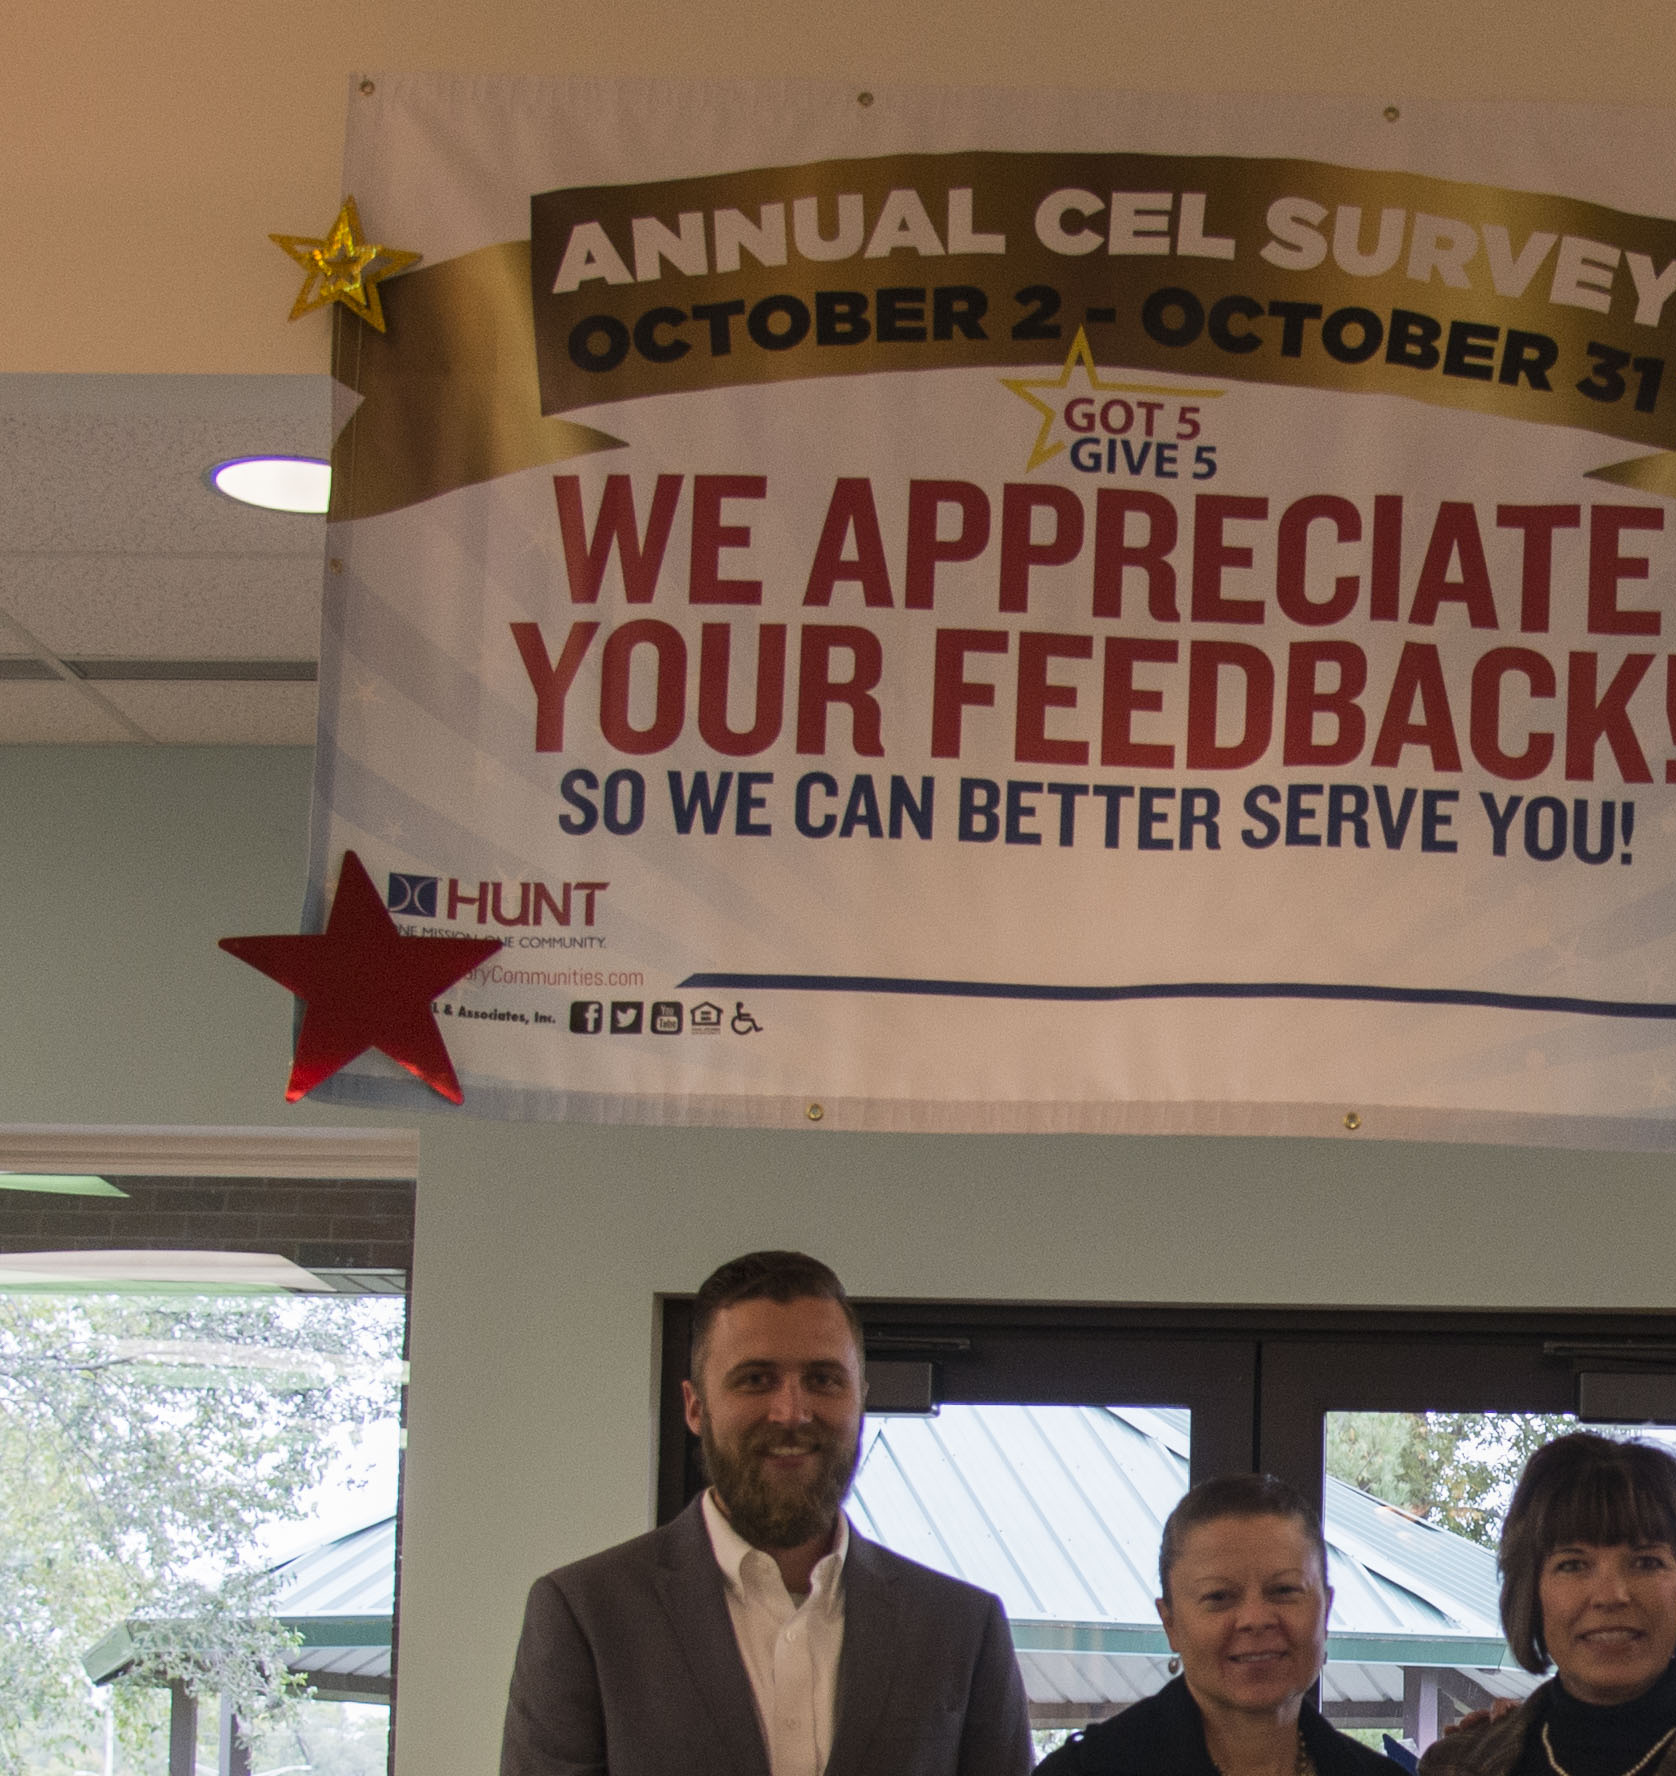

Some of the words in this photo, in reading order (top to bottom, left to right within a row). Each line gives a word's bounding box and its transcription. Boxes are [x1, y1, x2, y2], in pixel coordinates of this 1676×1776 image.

[552, 187, 1005, 294] ANNUAL
[1035, 188, 1235, 261] CEL
[567, 284, 989, 373] OCTOBER
[1010, 285, 1062, 341] 2
[1141, 287, 1559, 392] OCTOBER
[1575, 340, 1665, 414] 31
[1064, 397, 1163, 438] GOT
[1176, 406, 1201, 441] 5
[1070, 437, 1179, 479] GIVE
[1193, 445, 1217, 480] 5
[553, 474, 768, 606] WE
[801, 477, 1665, 636] APPRECIATE
[509, 618, 885, 758] YOUR
[558, 768, 646, 836] SO
[667, 769, 774, 837] WE
[794, 771, 935, 841] CAN
[958, 776, 1221, 851] BETTER
[1241, 783, 1459, 854] SERVE
[1478, 790, 1635, 865] YOU!
[447, 878, 610, 926] HUNT
[397, 924, 418, 937] NE
[465, 964, 644, 987] aryCommunities.com
[443, 1003, 453, 1016] &
[458, 1005, 529, 1025] Associates,
[534, 1011, 556, 1024] Inc.
